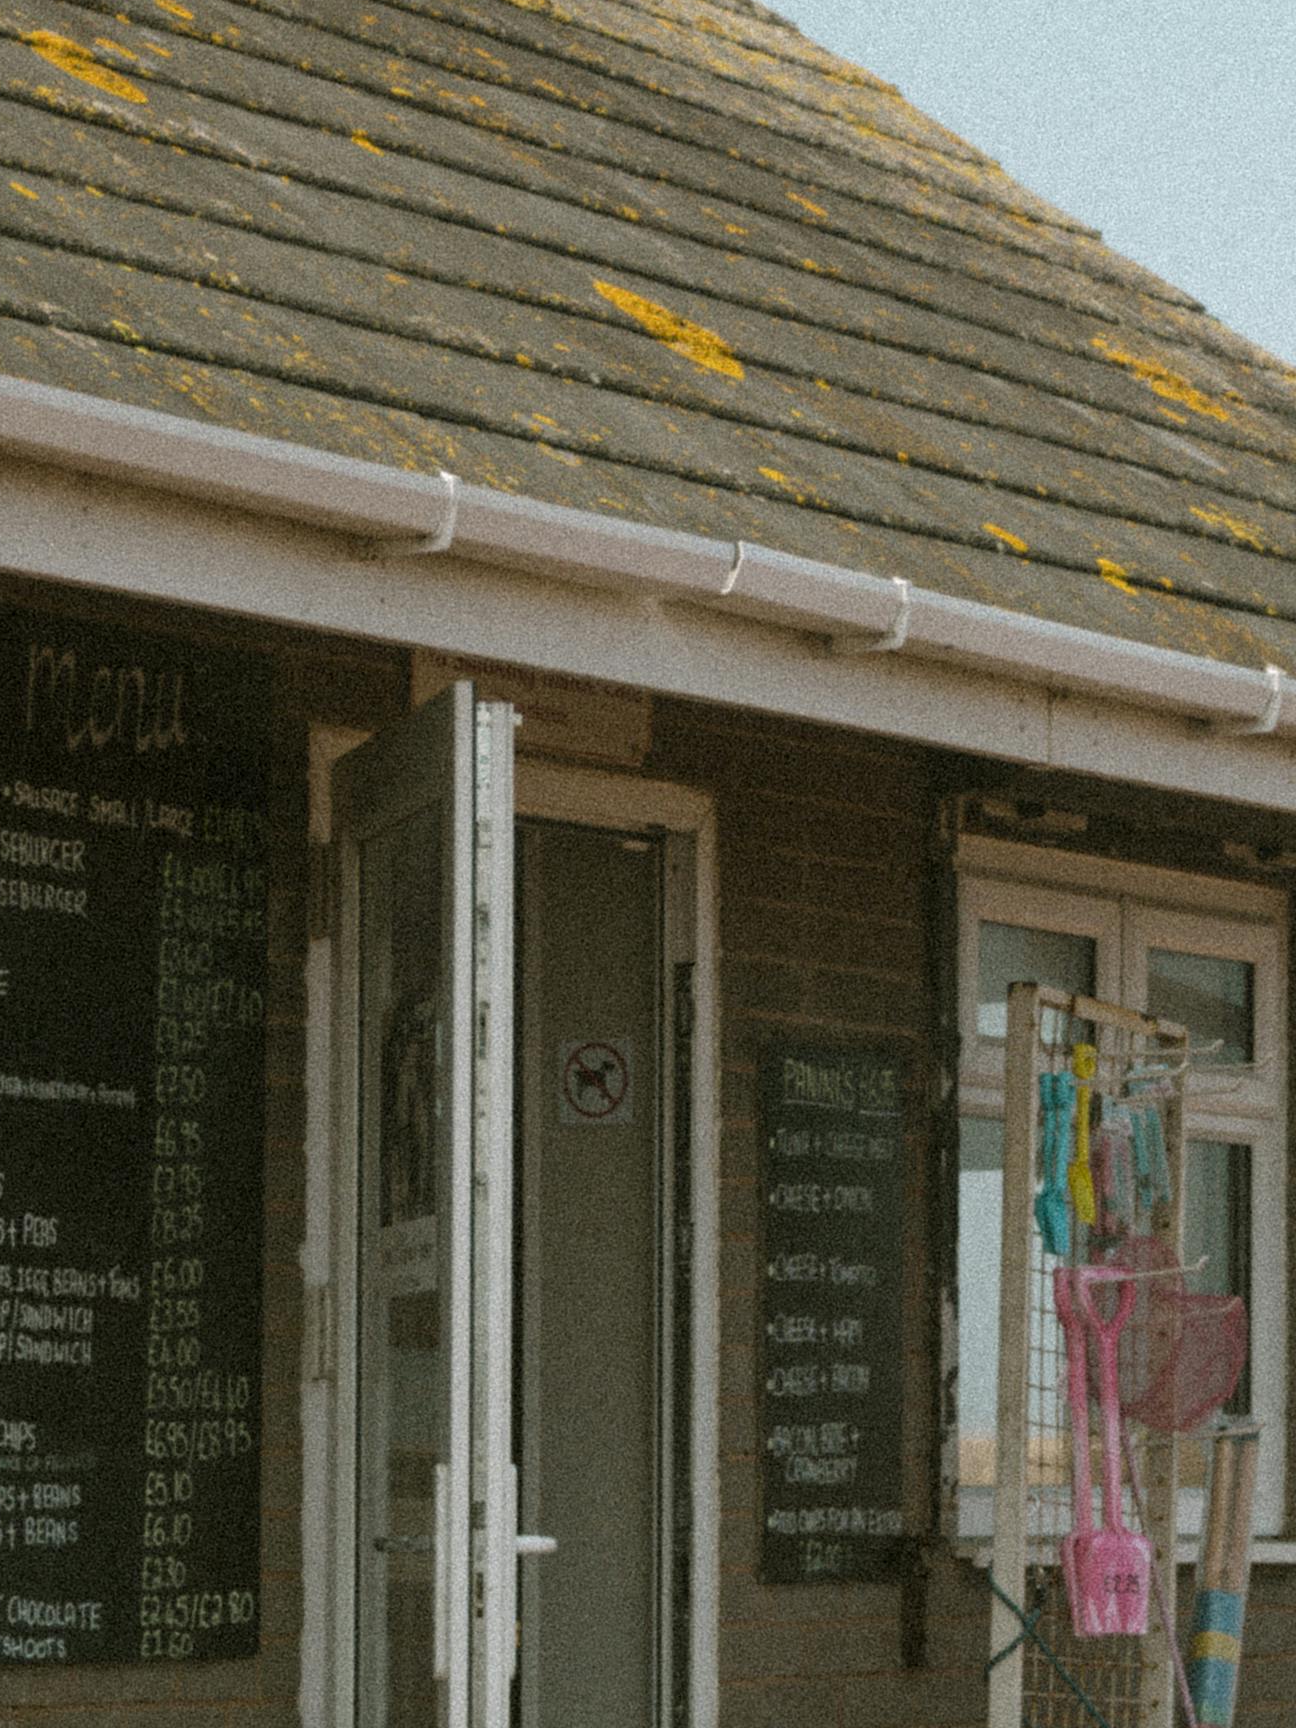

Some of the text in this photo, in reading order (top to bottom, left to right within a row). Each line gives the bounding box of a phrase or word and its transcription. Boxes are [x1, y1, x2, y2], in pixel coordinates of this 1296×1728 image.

[32, 1483, 82, 1511] BEANS
[24, 1515, 80, 1547] BEANS
[7, 1595, 104, 1631] CHOCOLATE
